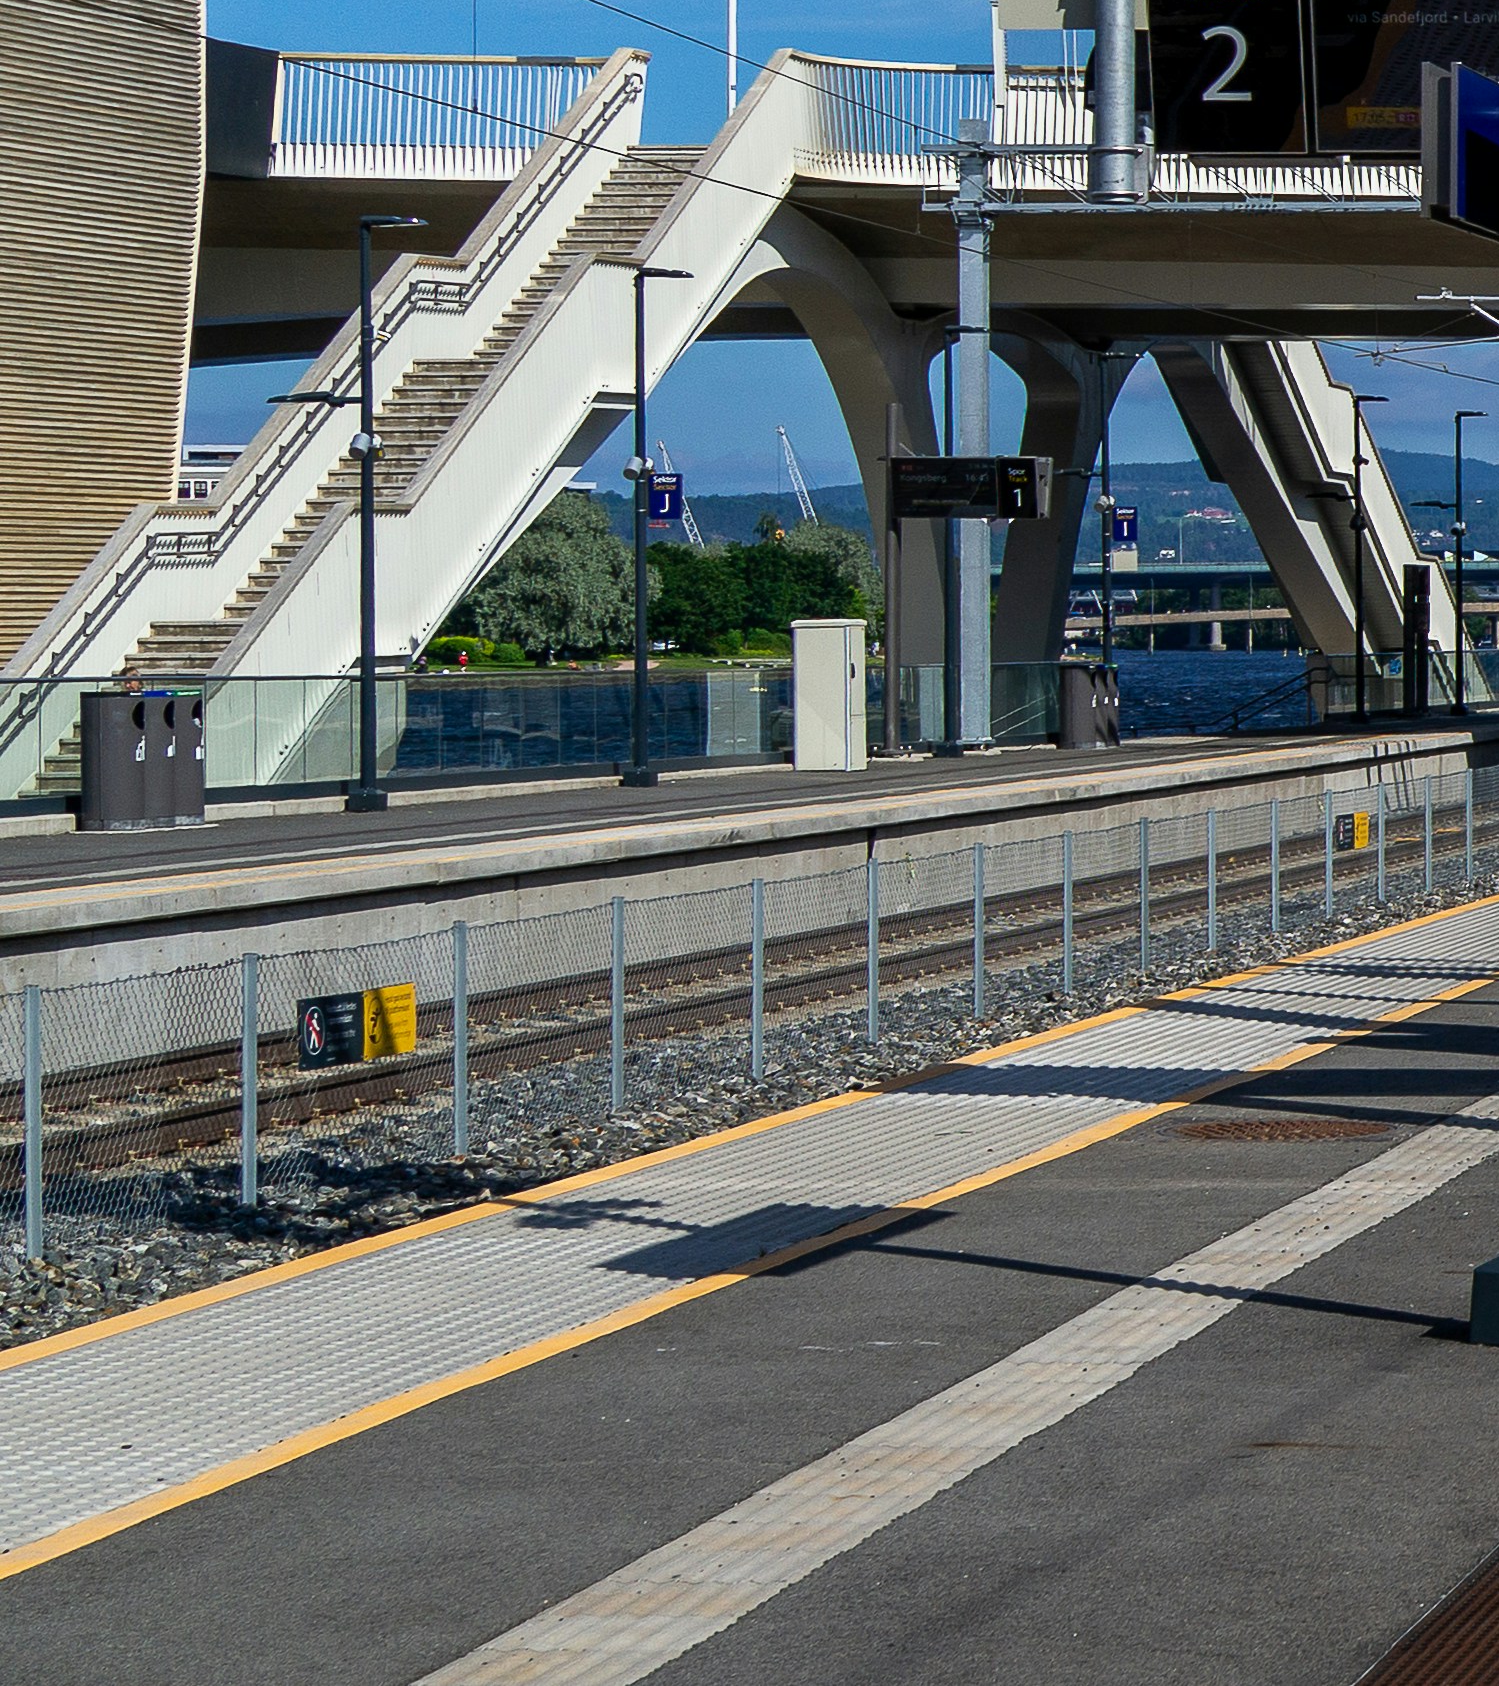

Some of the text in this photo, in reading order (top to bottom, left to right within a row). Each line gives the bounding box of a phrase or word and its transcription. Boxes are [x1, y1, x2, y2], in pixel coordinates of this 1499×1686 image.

[1346, 11, 1368, 24] via
[1371, 10, 1448, 27] Sandefjord
[1202, 25, 1253, 101] 2
[659, 493, 669, 513] J
[1013, 488, 1021, 508] 1
